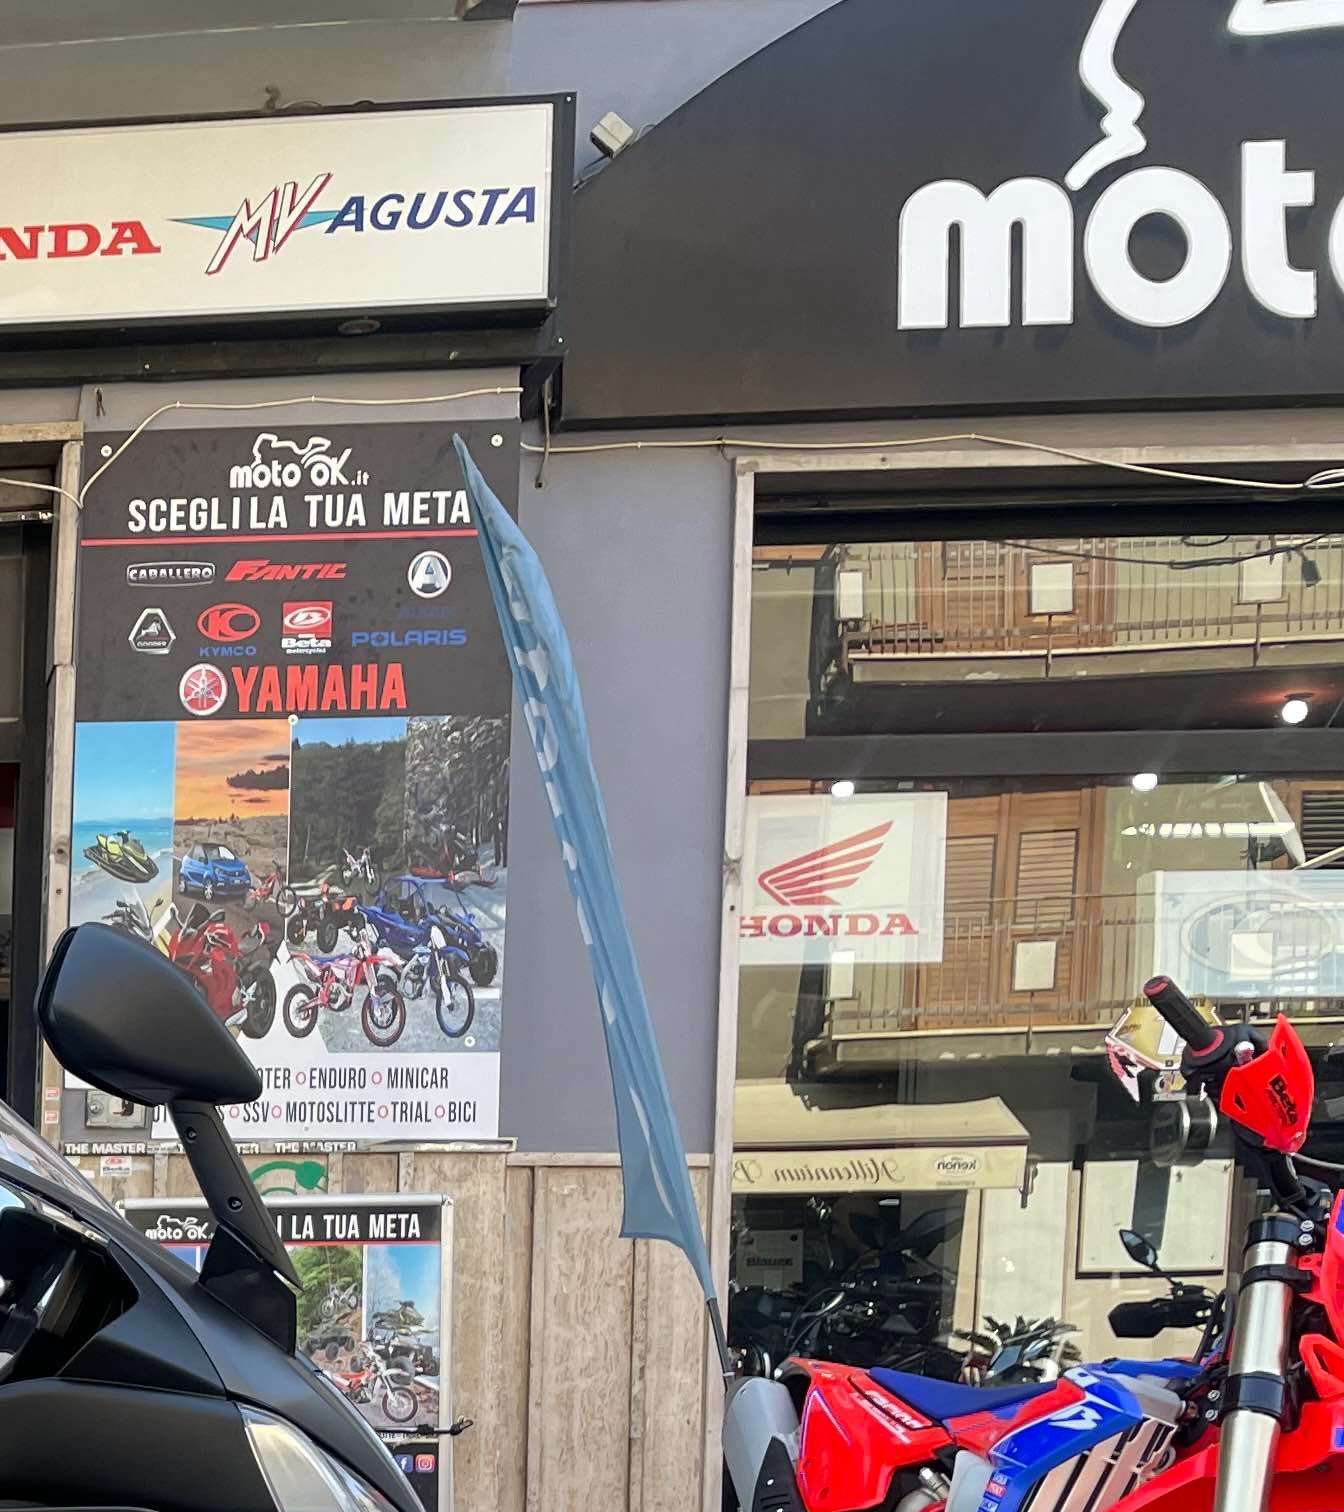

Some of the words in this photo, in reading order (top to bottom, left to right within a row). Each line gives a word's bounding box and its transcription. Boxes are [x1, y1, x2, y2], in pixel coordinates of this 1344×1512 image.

[204, 171, 334, 275] MV
[325, 186, 537, 234] AGUSTA
[897, 139, 1344, 330] mot
[229, 462, 301, 489] moto
[127, 497, 241, 533] SCEGLI
[249, 495, 288, 530] LA
[304, 494, 367, 528] TUA
[383, 491, 472, 526] META
[128, 566, 214, 582] CABALLERO
[224, 559, 347, 582] FANTIC
[281, 636, 332, 649] Beta
[351, 628, 467, 648] POLARIS
[199, 645, 257, 657] KYMCO
[230, 662, 408, 713] YAMAHA
[738, 914, 918, 938] HONDA
[309, 1066, 367, 1090] ENDURO
[386, 1067, 450, 1090] MINICAR
[242, 1101, 269, 1123] SSV
[285, 1100, 375, 1124] MOTOSLITTE
[391, 1100, 432, 1123] TRIAL
[448, 1100, 477, 1123] BICI
[65, 1143, 89, 1155] THE
[91, 1143, 146, 1155] MASTER
[292, 1216, 314, 1239] LA
[323, 1215, 360, 1239] TUA
[369, 1213, 421, 1238] META
